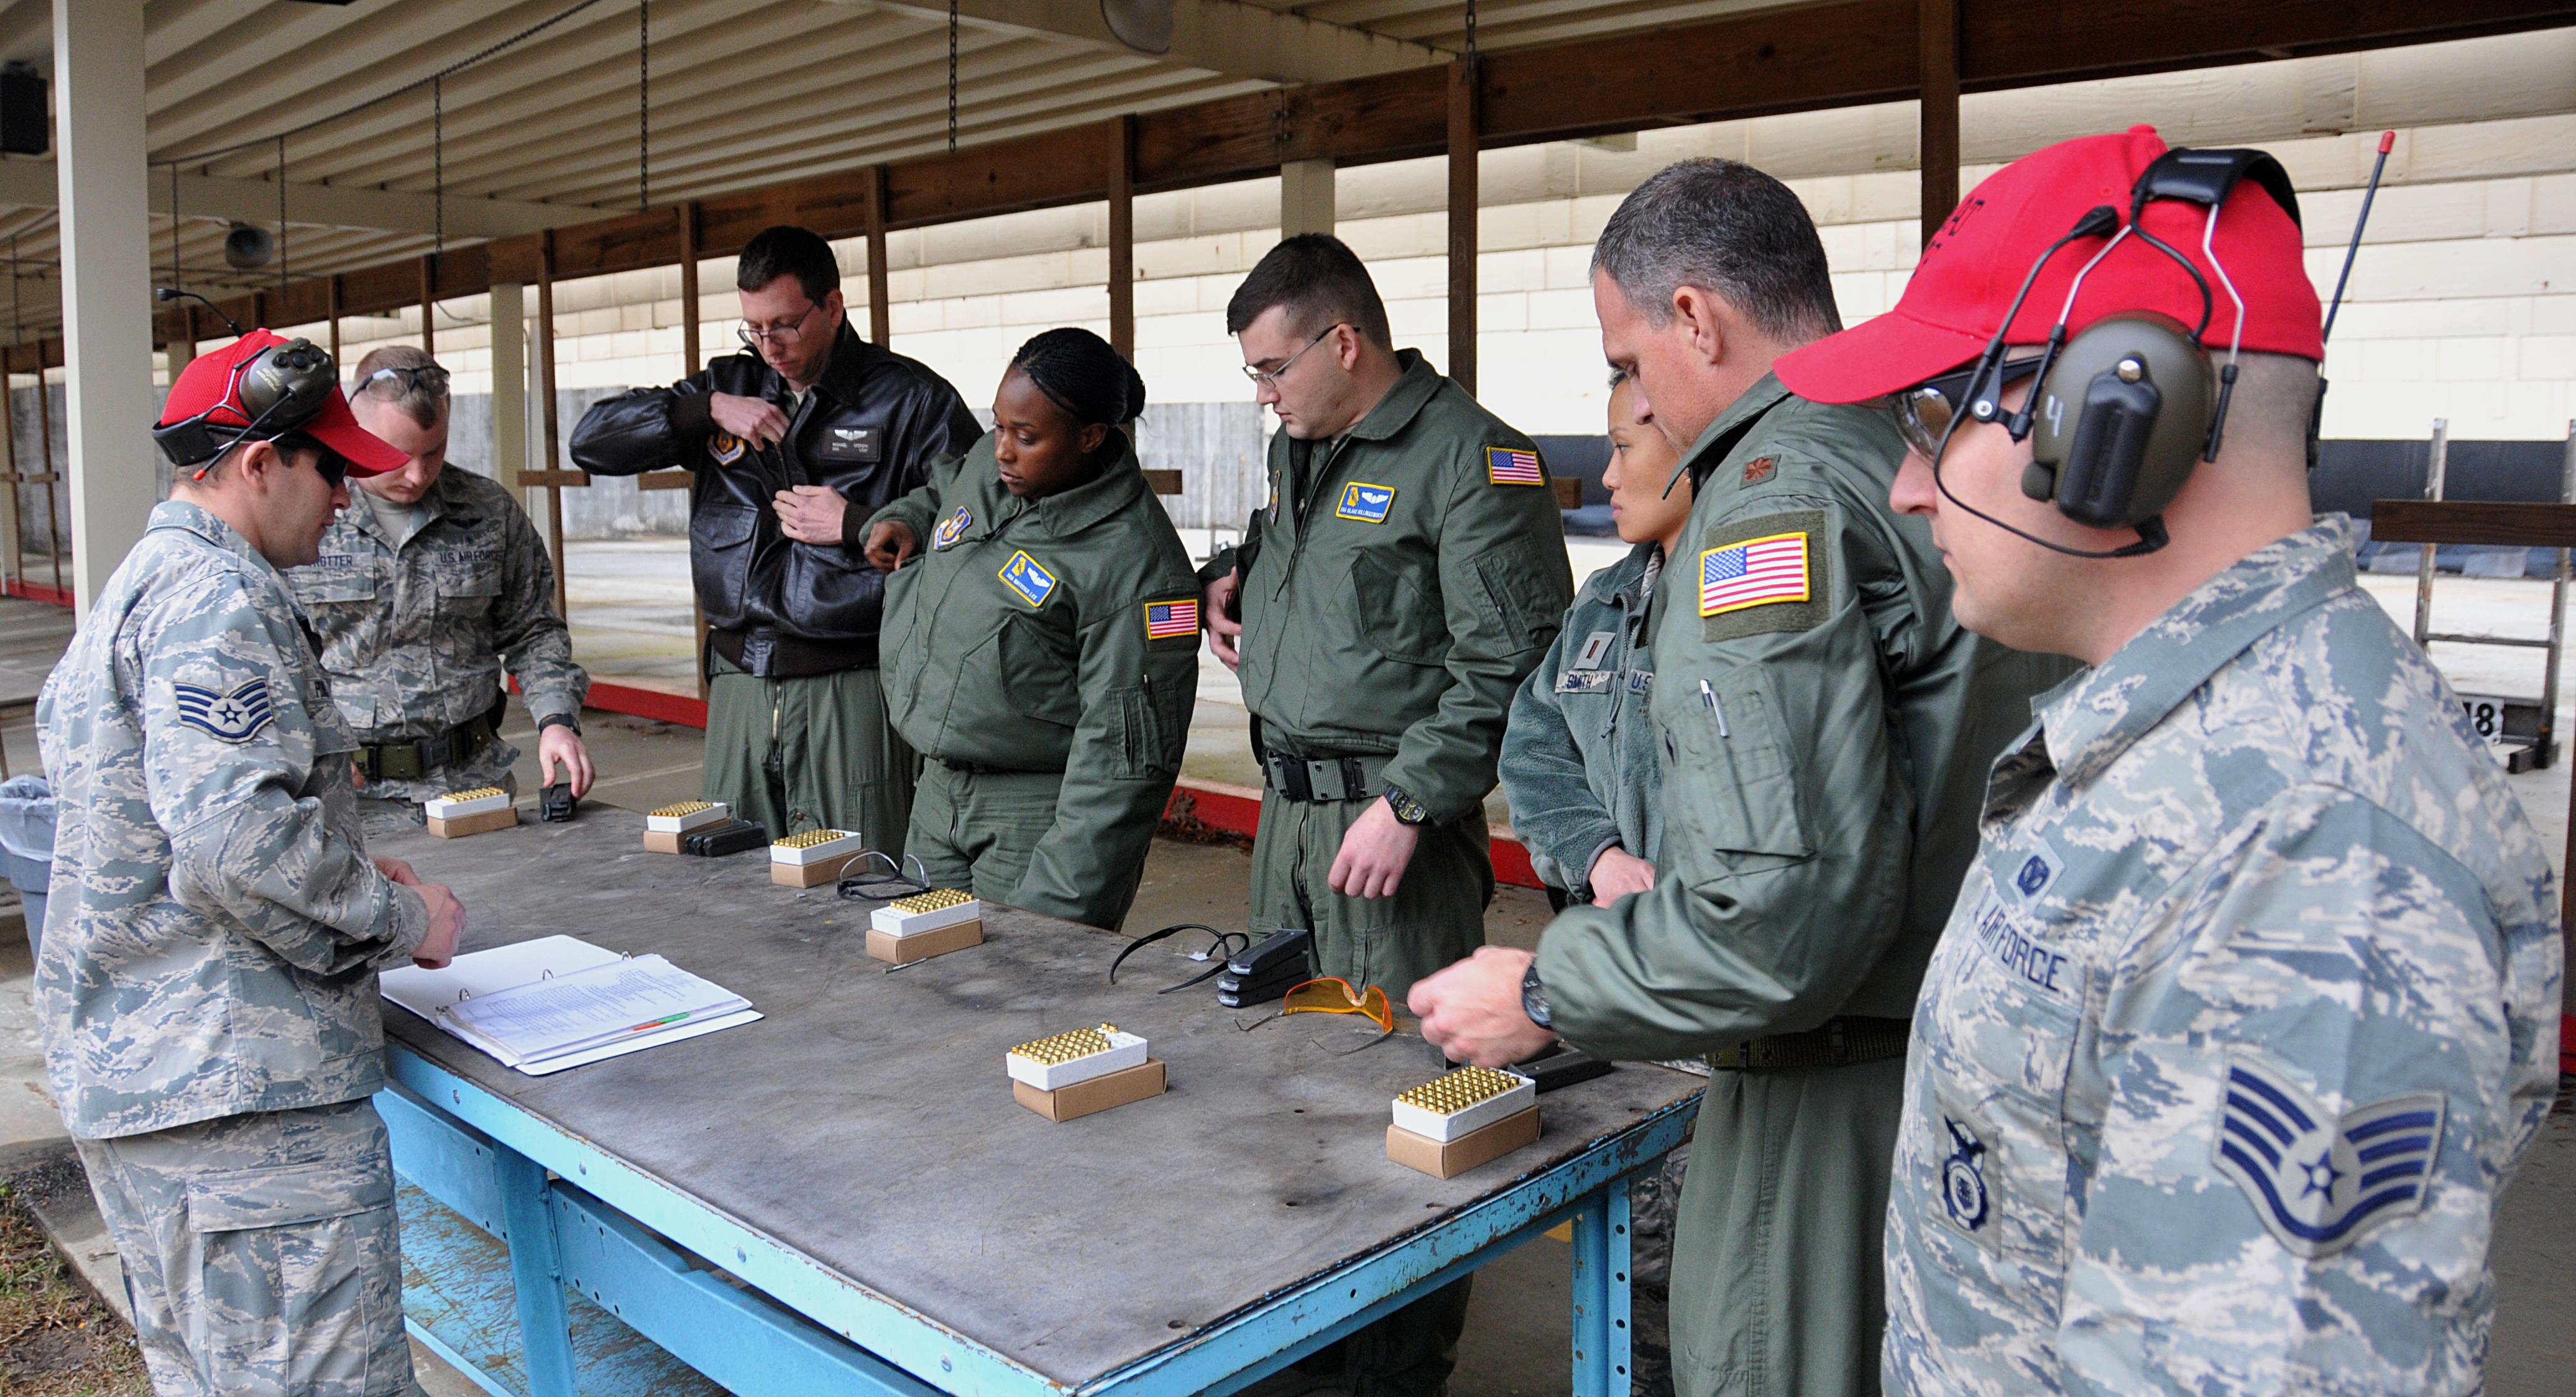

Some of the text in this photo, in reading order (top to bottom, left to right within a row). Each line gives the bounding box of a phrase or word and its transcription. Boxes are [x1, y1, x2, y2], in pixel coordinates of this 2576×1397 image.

[2046, 394, 2064, 437] 4
[458, 551, 472, 562] AIR
[1566, 674, 1594, 690] SMITH
[1978, 904, 2068, 993] AIR FORCE
